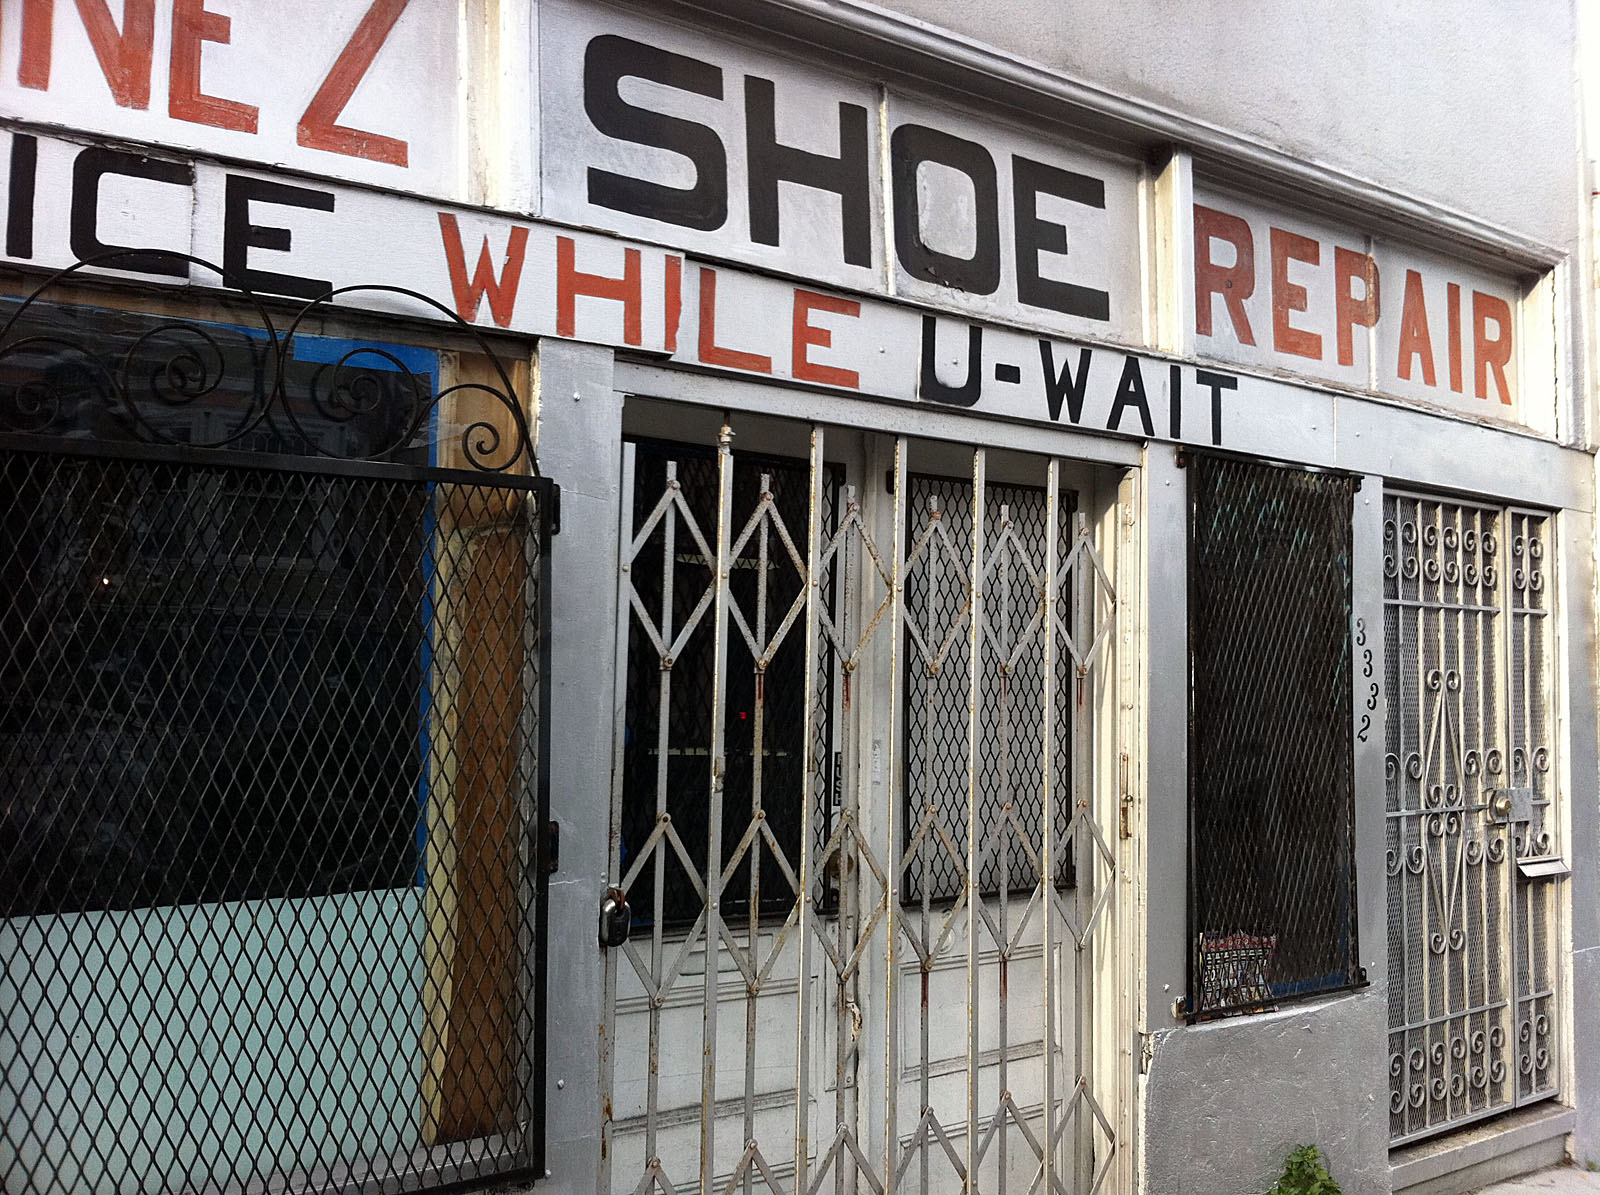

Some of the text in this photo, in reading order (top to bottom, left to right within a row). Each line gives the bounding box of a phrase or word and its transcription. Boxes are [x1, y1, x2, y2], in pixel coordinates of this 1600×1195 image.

[6, 133, 1238, 446] ICE WHILE U-WAIT
[584, 34, 1110, 321] SHOE
[1193, 203, 1512, 405] REPAIR
[1356, 617, 1379, 743] 3332
